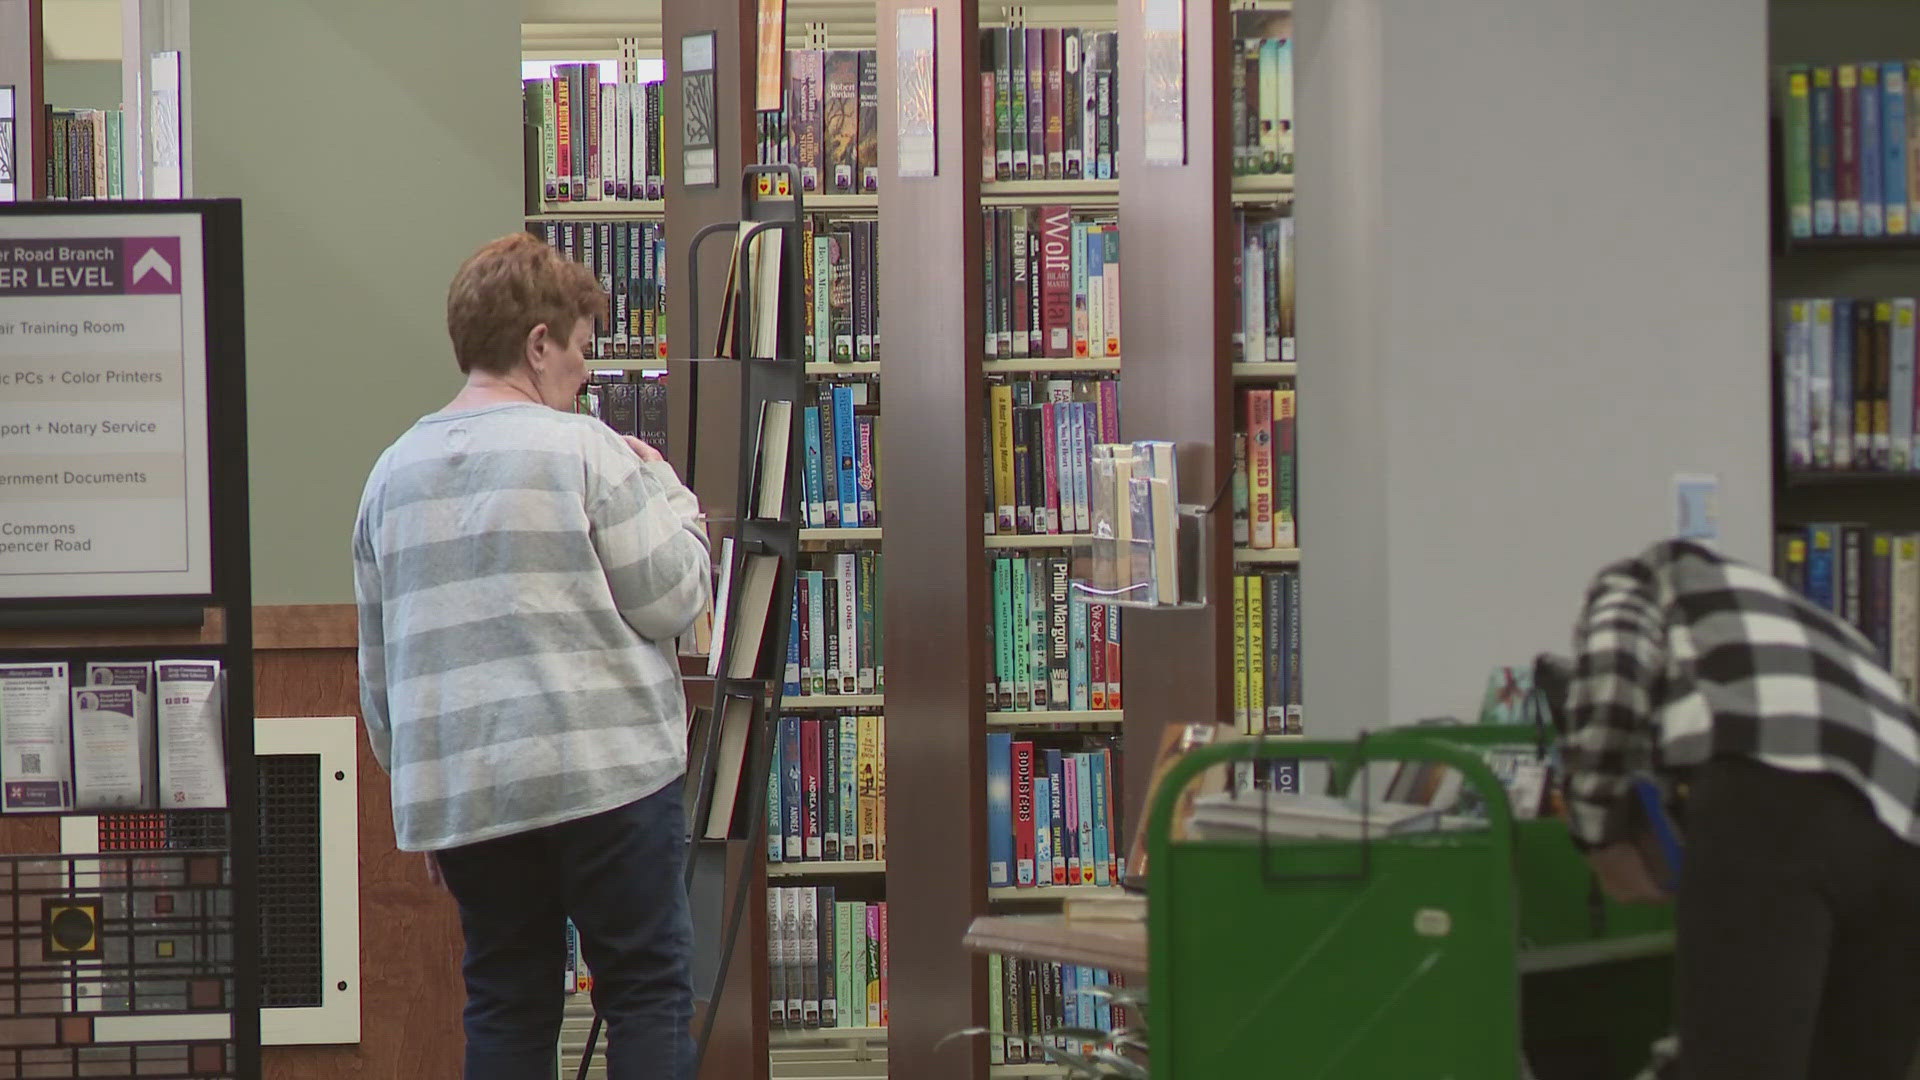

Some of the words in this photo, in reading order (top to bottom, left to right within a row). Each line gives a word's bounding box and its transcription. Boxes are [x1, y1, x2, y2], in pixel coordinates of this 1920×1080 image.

[808, 81, 817, 111] Jordan
[830, 83, 855, 91] Robert
[830, 91, 855, 99] Jordan
[565, 226, 573, 247] DAVID
[584, 227, 592, 248] DAVID
[600, 225, 609, 245] DAVID
[630, 227, 639, 248] DAVID
[644, 227, 653, 248] DAVID
[1013, 232, 1025, 256] DEAD
[1045, 211, 1070, 272] Wolf
[14, 247, 54, 262] Road
[59, 246, 114, 261] Branch
[37, 267, 114, 288] LEVEL
[1014, 257, 1026, 282] RUN
[615, 294, 627, 319] Tower
[816, 278, 827, 313] Missing
[859, 276, 867, 318] PERFUMIST
[1046, 291, 1070, 327] Hal
[21, 321, 79, 338] Training
[84, 320, 125, 335] Room
[15, 371, 44, 385] PCs
[61, 370, 101, 384] Color
[106, 370, 163, 384] Printers
[48, 420, 98, 437] Notary
[102, 420, 157, 434] Service
[822, 404, 832, 444] DESTINY
[824, 455, 834, 482] DEAD
[1000, 449, 1009, 473] Murder
[1061, 449, 1069, 468] Heart
[1075, 449, 1084, 468] Heart
[64, 470, 147, 485] Documents
[2, 522, 76, 536] Commons
[54, 538, 92, 552] Road
[1050, 563, 1068, 601] Phillip
[1271, 579, 1279, 606] SARAH
[1291, 579, 1300, 605] SARAH
[845, 604, 853, 631] ONES
[1109, 604, 1119, 641] stream
[1235, 598, 1245, 629] EVER
[1252, 598, 1262, 629] EVER
[1017, 634, 1023, 643] AT
[1036, 614, 1044, 657] PERFECT
[1051, 604, 1067, 659] Margolin
[1271, 608, 1279, 650] PEKKANEN
[1291, 608, 1300, 649] PEKKANEN
[1235, 635, 1246, 674] AFTER
[1252, 635, 1262, 674] AFTER
[1037, 660, 1045, 682] ALIB
[769, 772, 779, 804] ANDREA
[809, 774, 817, 805] ANDREA
[1051, 772, 1060, 795] MEANT
[1051, 796, 1060, 808] FOR
[1052, 809, 1060, 820] ME
[770, 804, 779, 828] KANE
[789, 805, 799, 833] ANDREA
[809, 810, 817, 835] KANE
[844, 809, 853, 837] ANDREA
[864, 807, 873, 836] ANDREA
